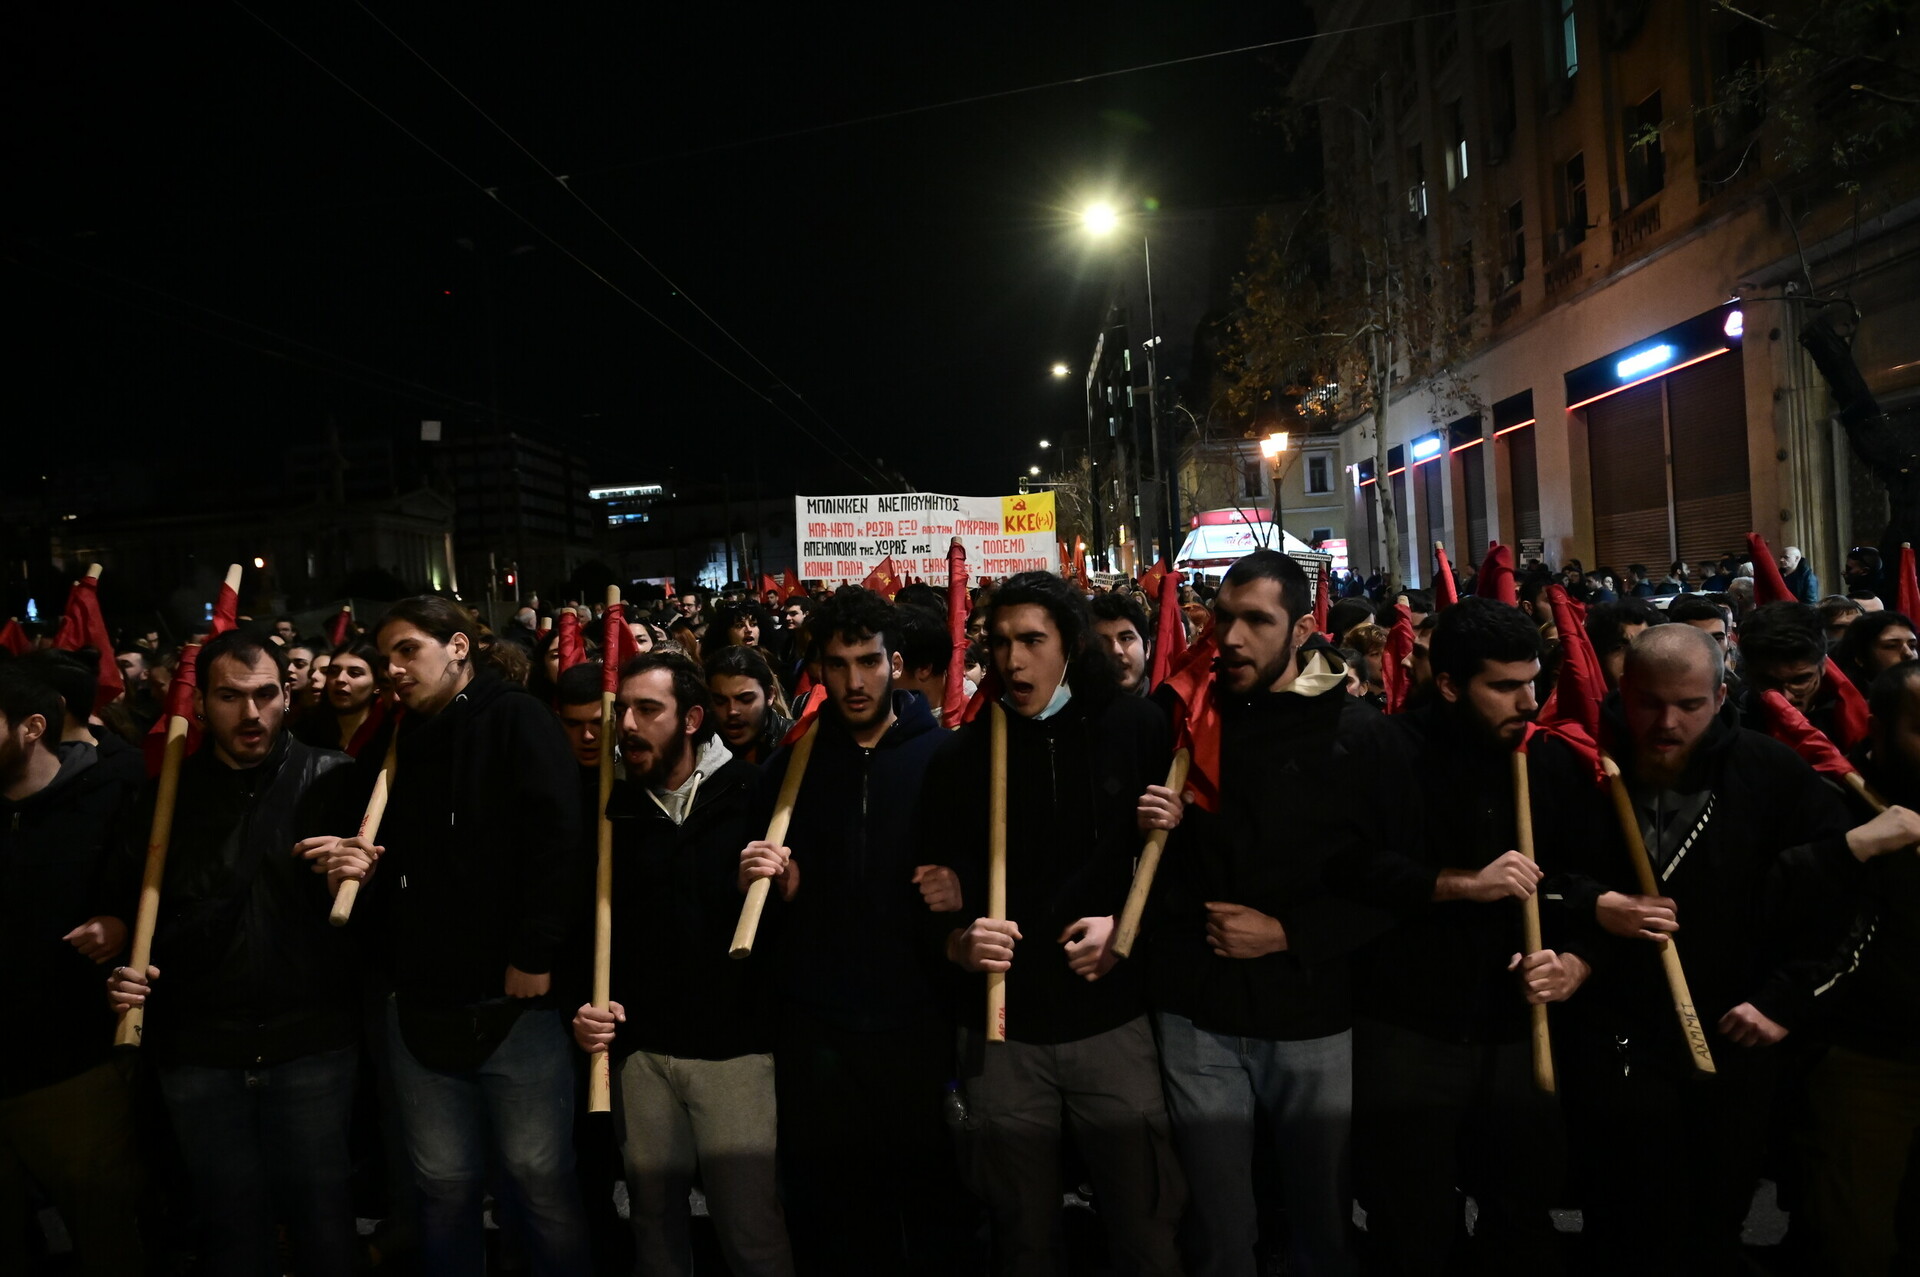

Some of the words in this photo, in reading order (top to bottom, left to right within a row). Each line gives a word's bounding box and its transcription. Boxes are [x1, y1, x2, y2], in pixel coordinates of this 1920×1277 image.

[807, 498, 868, 514] ΜΠΛΙΝΚΕΝ
[878, 495, 960, 512] ΑΝΕΠΙΘΥΜΗΤΟΣ
[808, 522, 854, 538] ΗΠΑ-ΝΑΤΟ
[866, 521, 894, 538] ΡΩΣΙΑ
[898, 520, 918, 536] ΕΞΩ
[955, 520, 1000, 536] ΟΥΚΡΑΝΙΑ
[804, 541, 857, 557] ΑΠΕΜΠΛΟΚΗ
[875, 540, 907, 556] ΧΩΡΑΣ
[912, 544, 931, 554] ΜΑΣ
[982, 538, 1025, 554] ΠΟΛΕΜΟ
[804, 561, 833, 577] ΚΟΙΝΗ
[836, 560, 864, 576] ΠΑΛΗ
